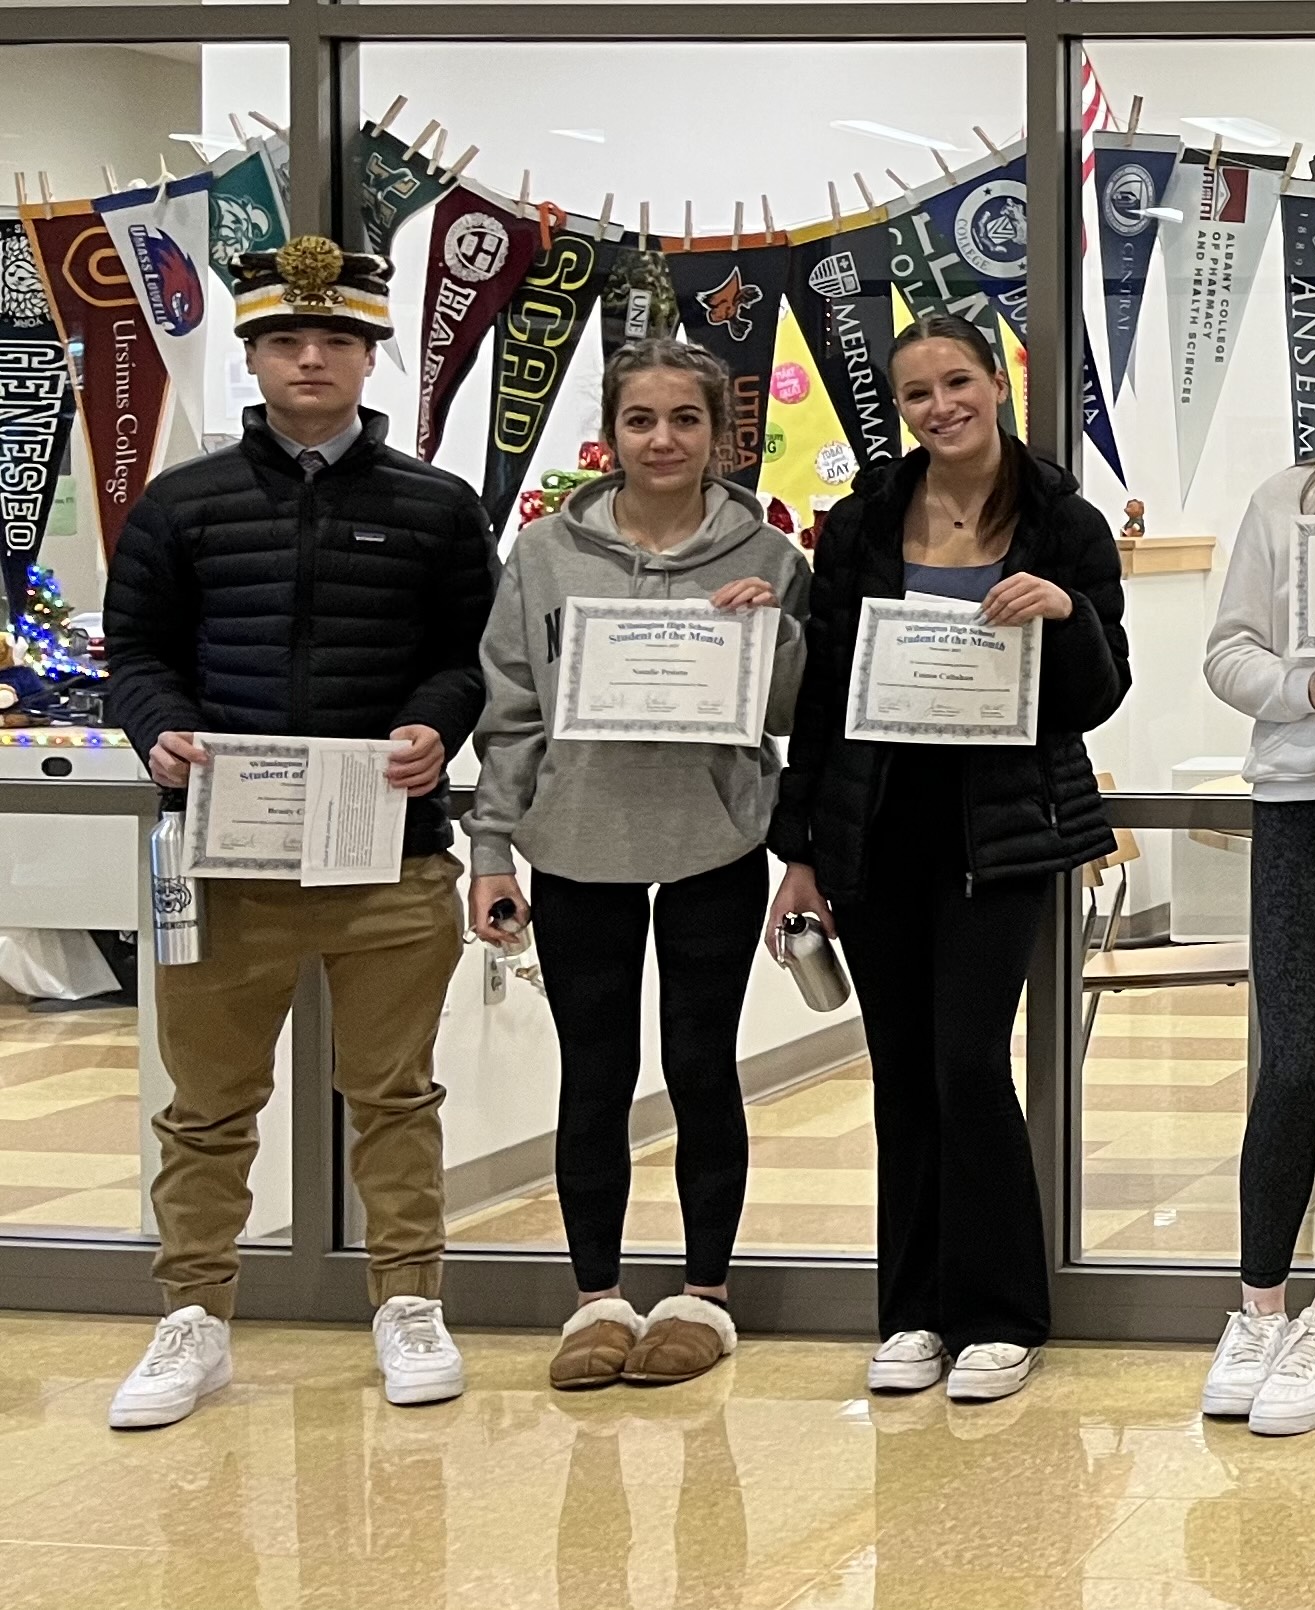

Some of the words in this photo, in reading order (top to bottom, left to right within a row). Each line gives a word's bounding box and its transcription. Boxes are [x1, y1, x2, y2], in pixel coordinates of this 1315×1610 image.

[956, 217, 989, 271] COLLEGE
[1195, 230, 1207, 260] AND
[1211, 231, 1221, 250] OF
[1222, 232, 1236, 292] ALBANY
[630, 295, 648, 336] UNE
[1189, 267, 1203, 325] HEALTH
[1202, 257, 1219, 340] PHARMACY
[494, 234, 595, 454] SCAD
[1214, 298, 1230, 363] COLLEGE
[111, 318, 137, 410] Ursinus
[1181, 332, 1197, 404] SCIENCES
[0, 340, 67, 551] GENESEO
[734, 375, 760, 470] UTICA
[105, 413, 139, 505] College
[827, 462, 850, 479] DAY
[608, 631, 652, 645] Student
[654, 630, 668, 640] of
[669, 630, 686, 641] the
[688, 632, 725, 647] Month
[666, 621, 686, 631] High
[688, 622, 715, 632] School
[896, 634, 936, 646] Student
[938, 634, 950, 644] of
[951, 635, 968, 646] the
[970, 636, 1006, 652] Month
[949, 625, 967, 635] High
[969, 626, 996, 638] School
[239, 769, 289, 783] Student
[291, 769, 305, 780] of
